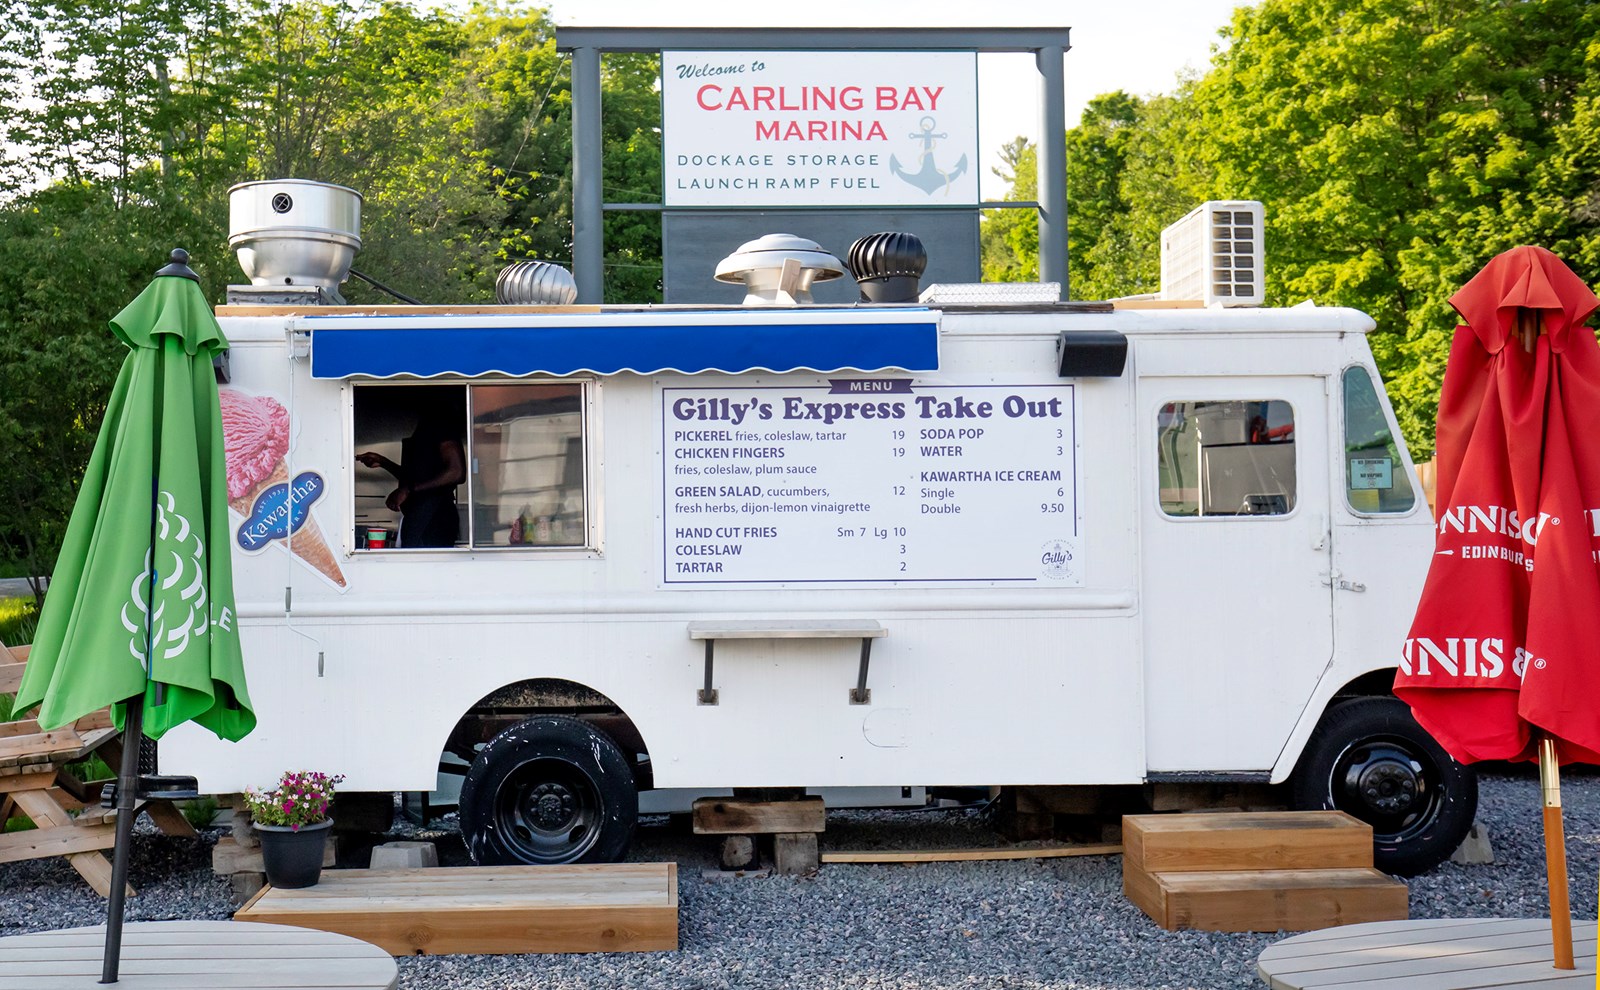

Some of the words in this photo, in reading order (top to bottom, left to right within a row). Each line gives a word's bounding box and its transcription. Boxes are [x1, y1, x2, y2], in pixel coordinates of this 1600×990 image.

[676, 64, 744, 79] Welcome
[752, 61, 765, 71] to
[697, 84, 863, 110] CARLING
[876, 87, 944, 110] BAY
[756, 121, 888, 140] MARINA
[678, 155, 773, 165] DOCKAGE
[787, 155, 878, 165] STORAGE
[678, 178, 757, 189] LAUNCH
[767, 178, 819, 188] RAMP
[831, 178, 879, 188] FUEL
[850, 381, 893, 391] MENU
[673, 397, 772, 425] Gilly's
[783, 397, 905, 424] Express
[915, 396, 992, 418] Take
[1003, 396, 1062, 417] Out
[675, 431, 733, 442] PICKEREL
[736, 431, 762, 443] fries,
[765, 431, 813, 442] coleslaw,
[816, 432, 847, 441] tartar
[893, 430, 905, 440] 19
[921, 429, 956, 440] SODA
[959, 429, 985, 440] POP
[1057, 429, 1063, 439] 3
[675, 448, 729, 459] CHICKEN
[733, 448, 785, 459] FINGERS
[893, 448, 906, 458] 19
[920, 446, 963, 457] WATER
[1057, 446, 1063, 456] 3
[675, 465, 701, 476] fries,
[704, 464, 753, 476] coleslaw,
[756, 464, 784, 477] plum
[787, 466, 817, 474] sauce
[921, 471, 992, 482] KAWARTHA
[996, 471, 1014, 482] ICE
[1018, 471, 1061, 482] CREAM
[675, 487, 716, 498] GREEN
[720, 486, 764, 498] SALAD,
[767, 486, 830, 498] cucumbers,
[894, 486, 906, 496] 12
[921, 488, 955, 501] Single
[1058, 488, 1065, 497] 6
[675, 503, 702, 514] fresh
[706, 503, 739, 514] herbs,
[742, 503, 808, 515] dijon-lemon
[811, 502, 871, 515] vinaigrette
[922, 504, 961, 514] Double
[1041, 503, 1065, 513] 9.50
[676, 528, 713, 539] HAND
[716, 528, 741, 539] CUT
[744, 527, 778, 538] FRIES
[838, 527, 855, 538] Sm
[860, 528, 867, 537] 7
[875, 527, 888, 540] Lg
[894, 527, 907, 537] 10
[676, 545, 743, 556] COLESLAW
[900, 545, 906, 554] 3
[1041, 550, 1074, 565] Gilly's
[676, 562, 723, 573] TARTAR
[901, 562, 907, 572] 2
